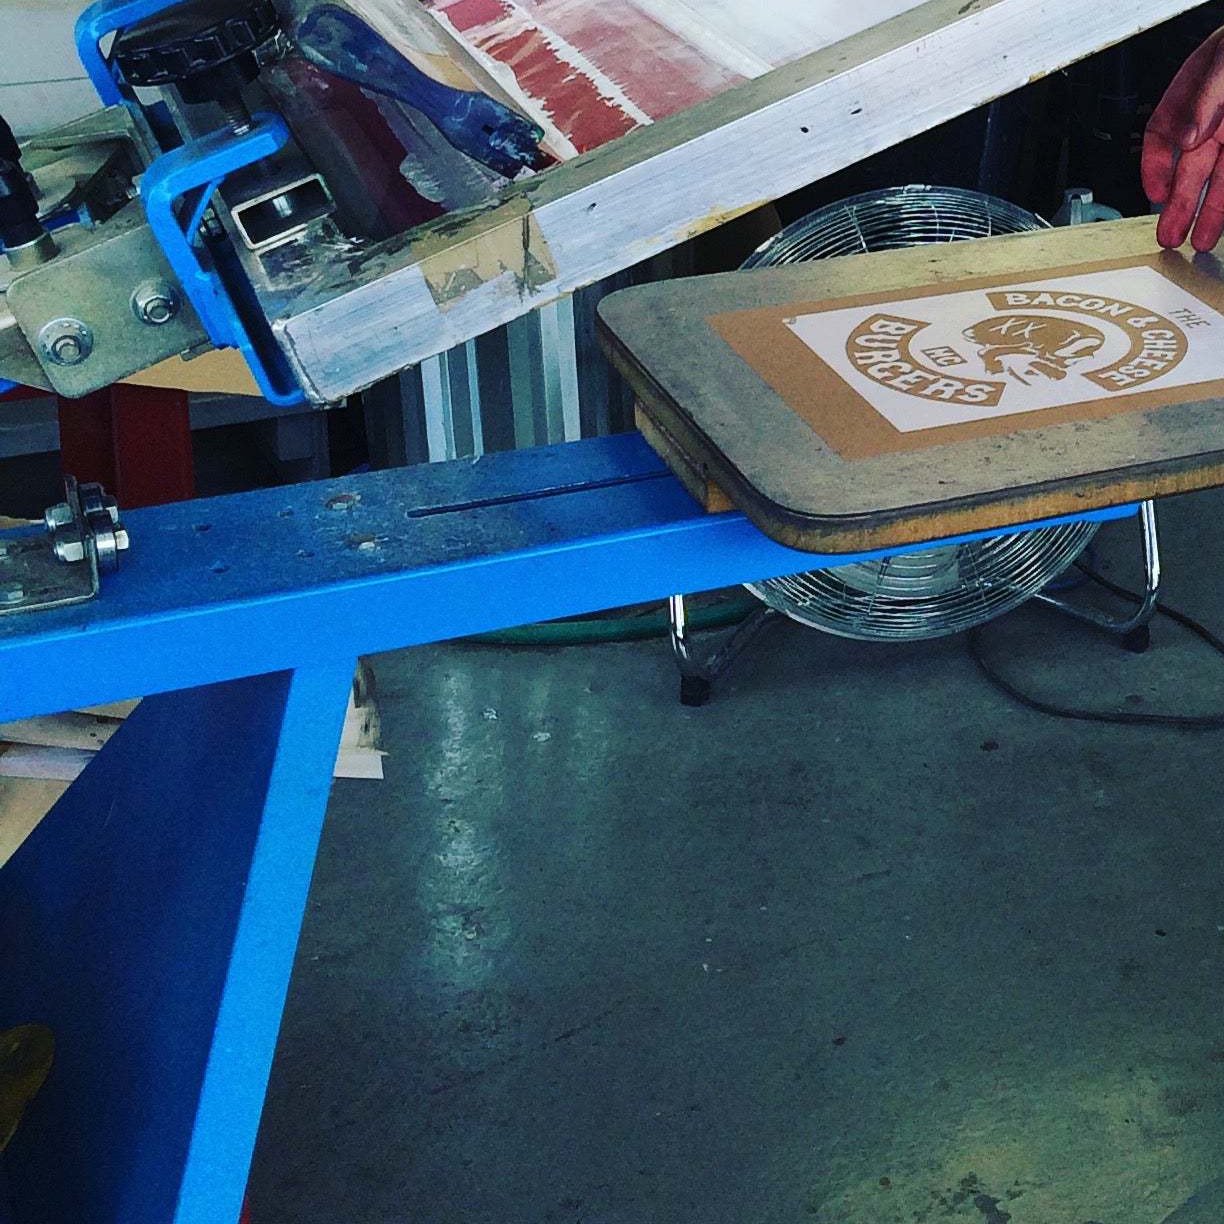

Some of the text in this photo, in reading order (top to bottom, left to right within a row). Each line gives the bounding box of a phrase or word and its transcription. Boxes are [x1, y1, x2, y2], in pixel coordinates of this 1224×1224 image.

[1004, 292, 1179, 387] BACON & CHEESE
[1169, 308, 1211, 329] THE
[854, 319, 997, 403] BURGERS
